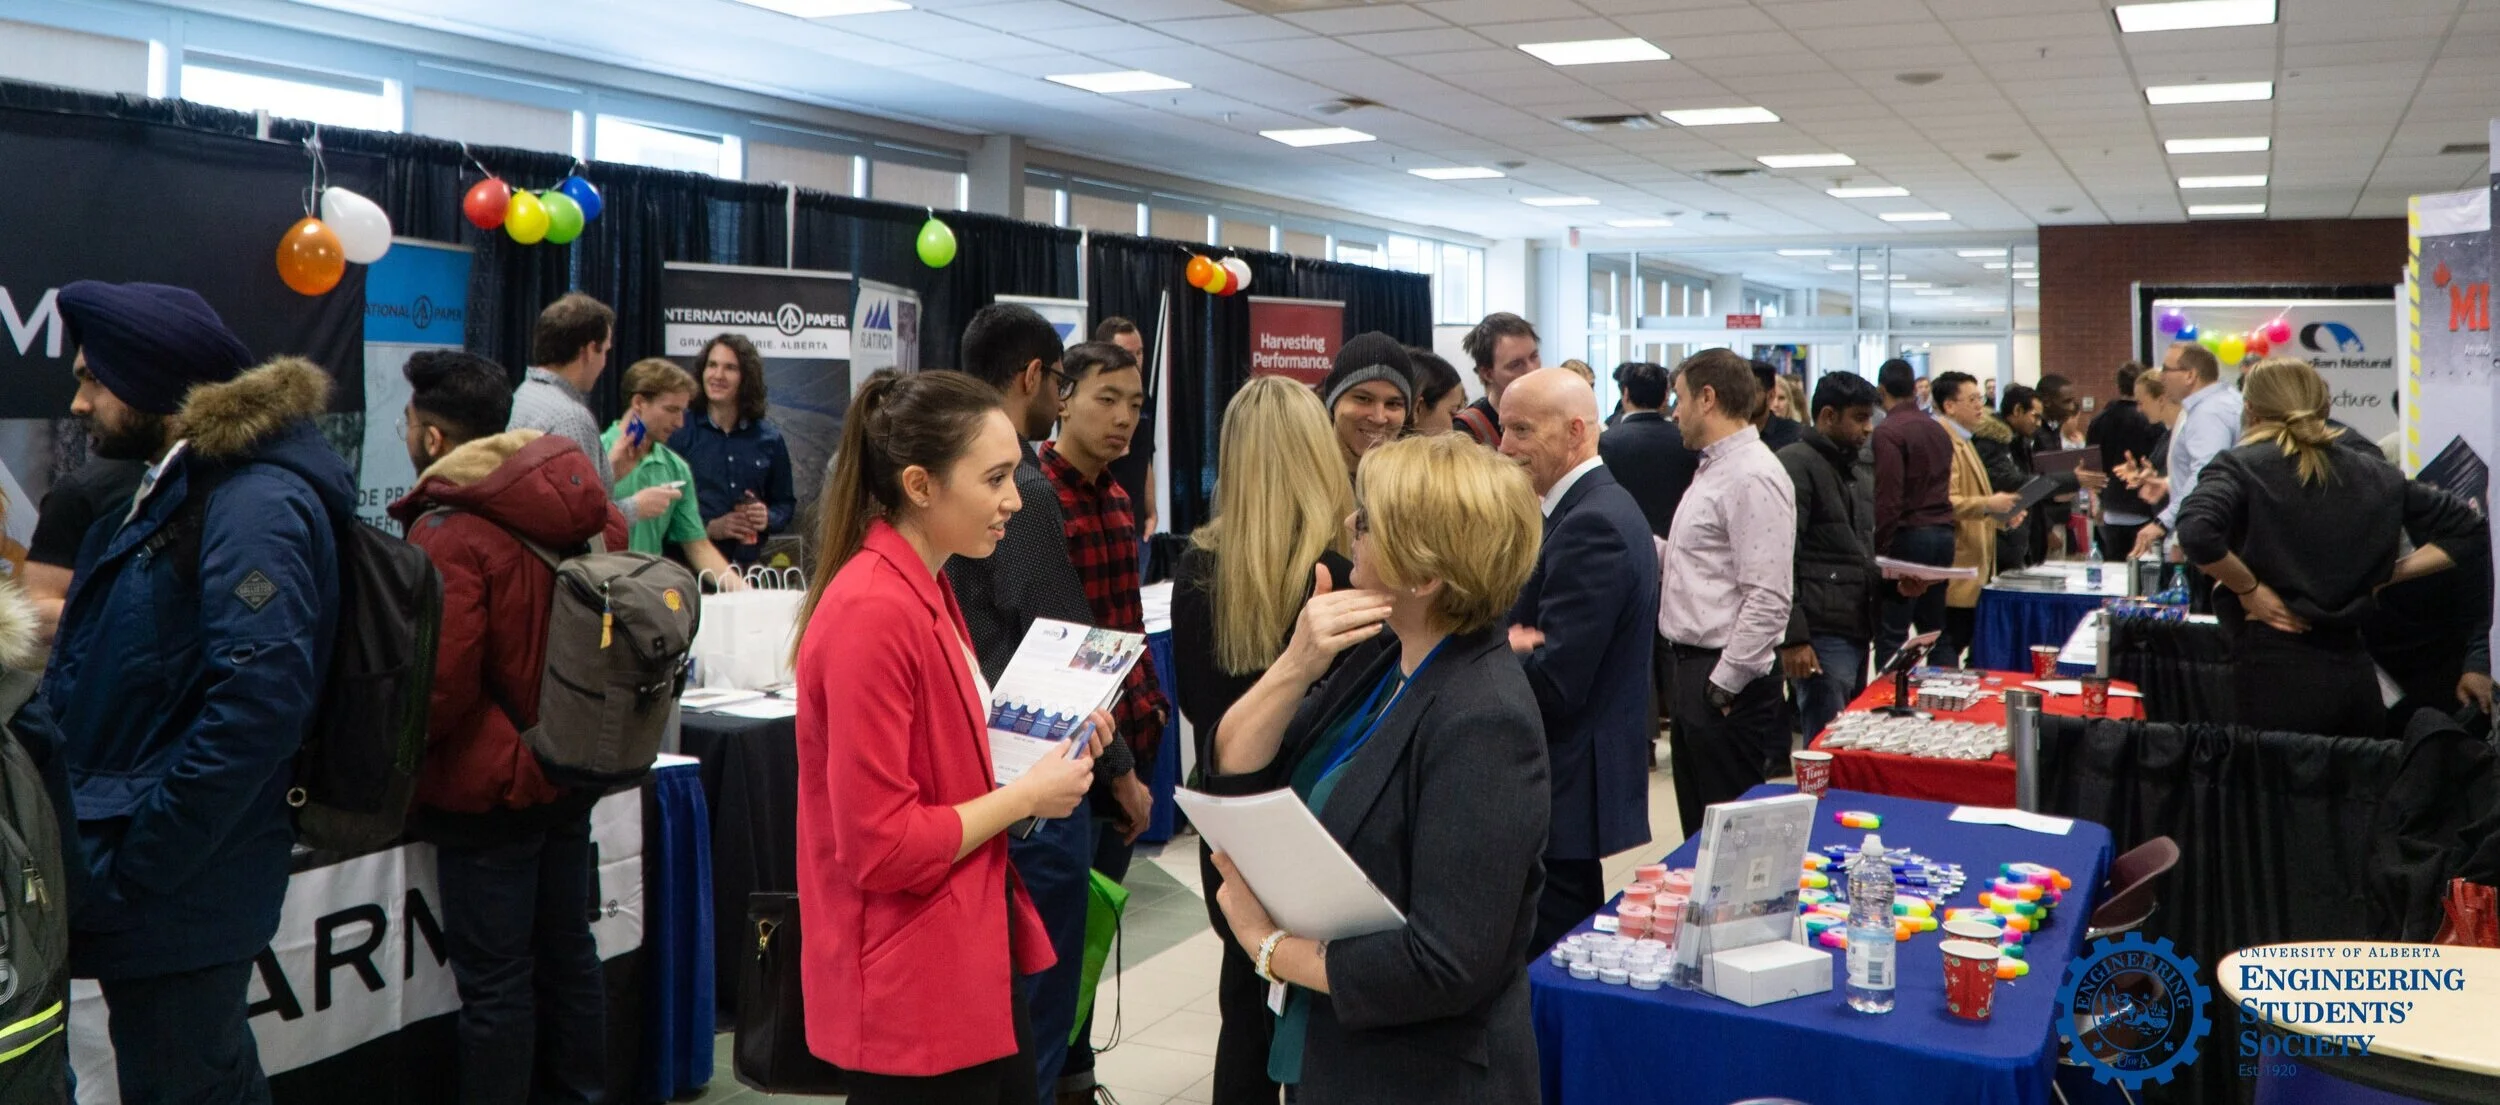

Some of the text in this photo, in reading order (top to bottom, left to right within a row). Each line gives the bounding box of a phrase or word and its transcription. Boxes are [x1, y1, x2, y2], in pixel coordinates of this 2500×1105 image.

[433, 308, 461, 321] PAPER
[806, 312, 847, 328] PAPER
[781, 341, 828, 350] ALBERTA
[1260, 333, 1326, 353] Harvesting
[1253, 351, 1333, 370] Performance.
[2341, 356, 2393, 369] Natural
[358, 488, 379, 506] DE
